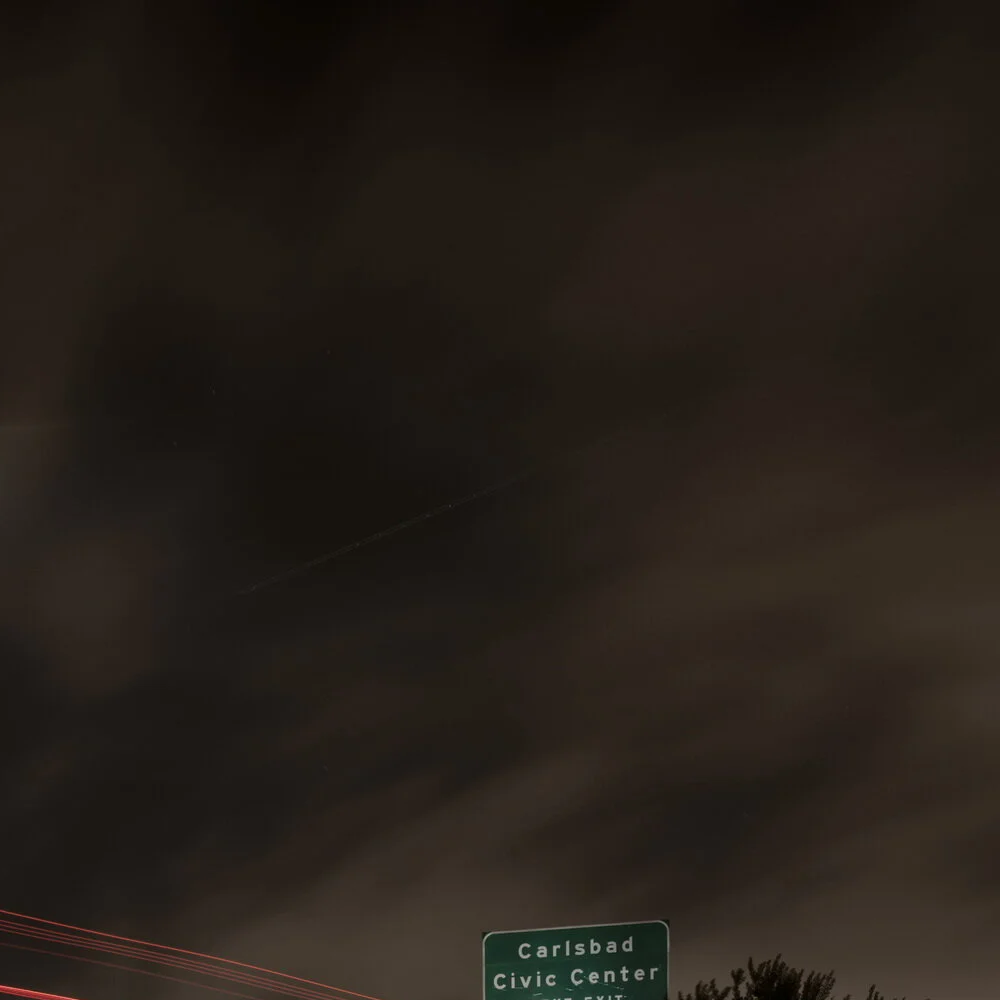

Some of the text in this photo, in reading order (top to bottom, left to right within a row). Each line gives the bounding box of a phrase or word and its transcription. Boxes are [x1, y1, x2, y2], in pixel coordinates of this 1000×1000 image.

[518, 936, 634, 960] Carlsbad
[493, 965, 659, 990] Civic Center
